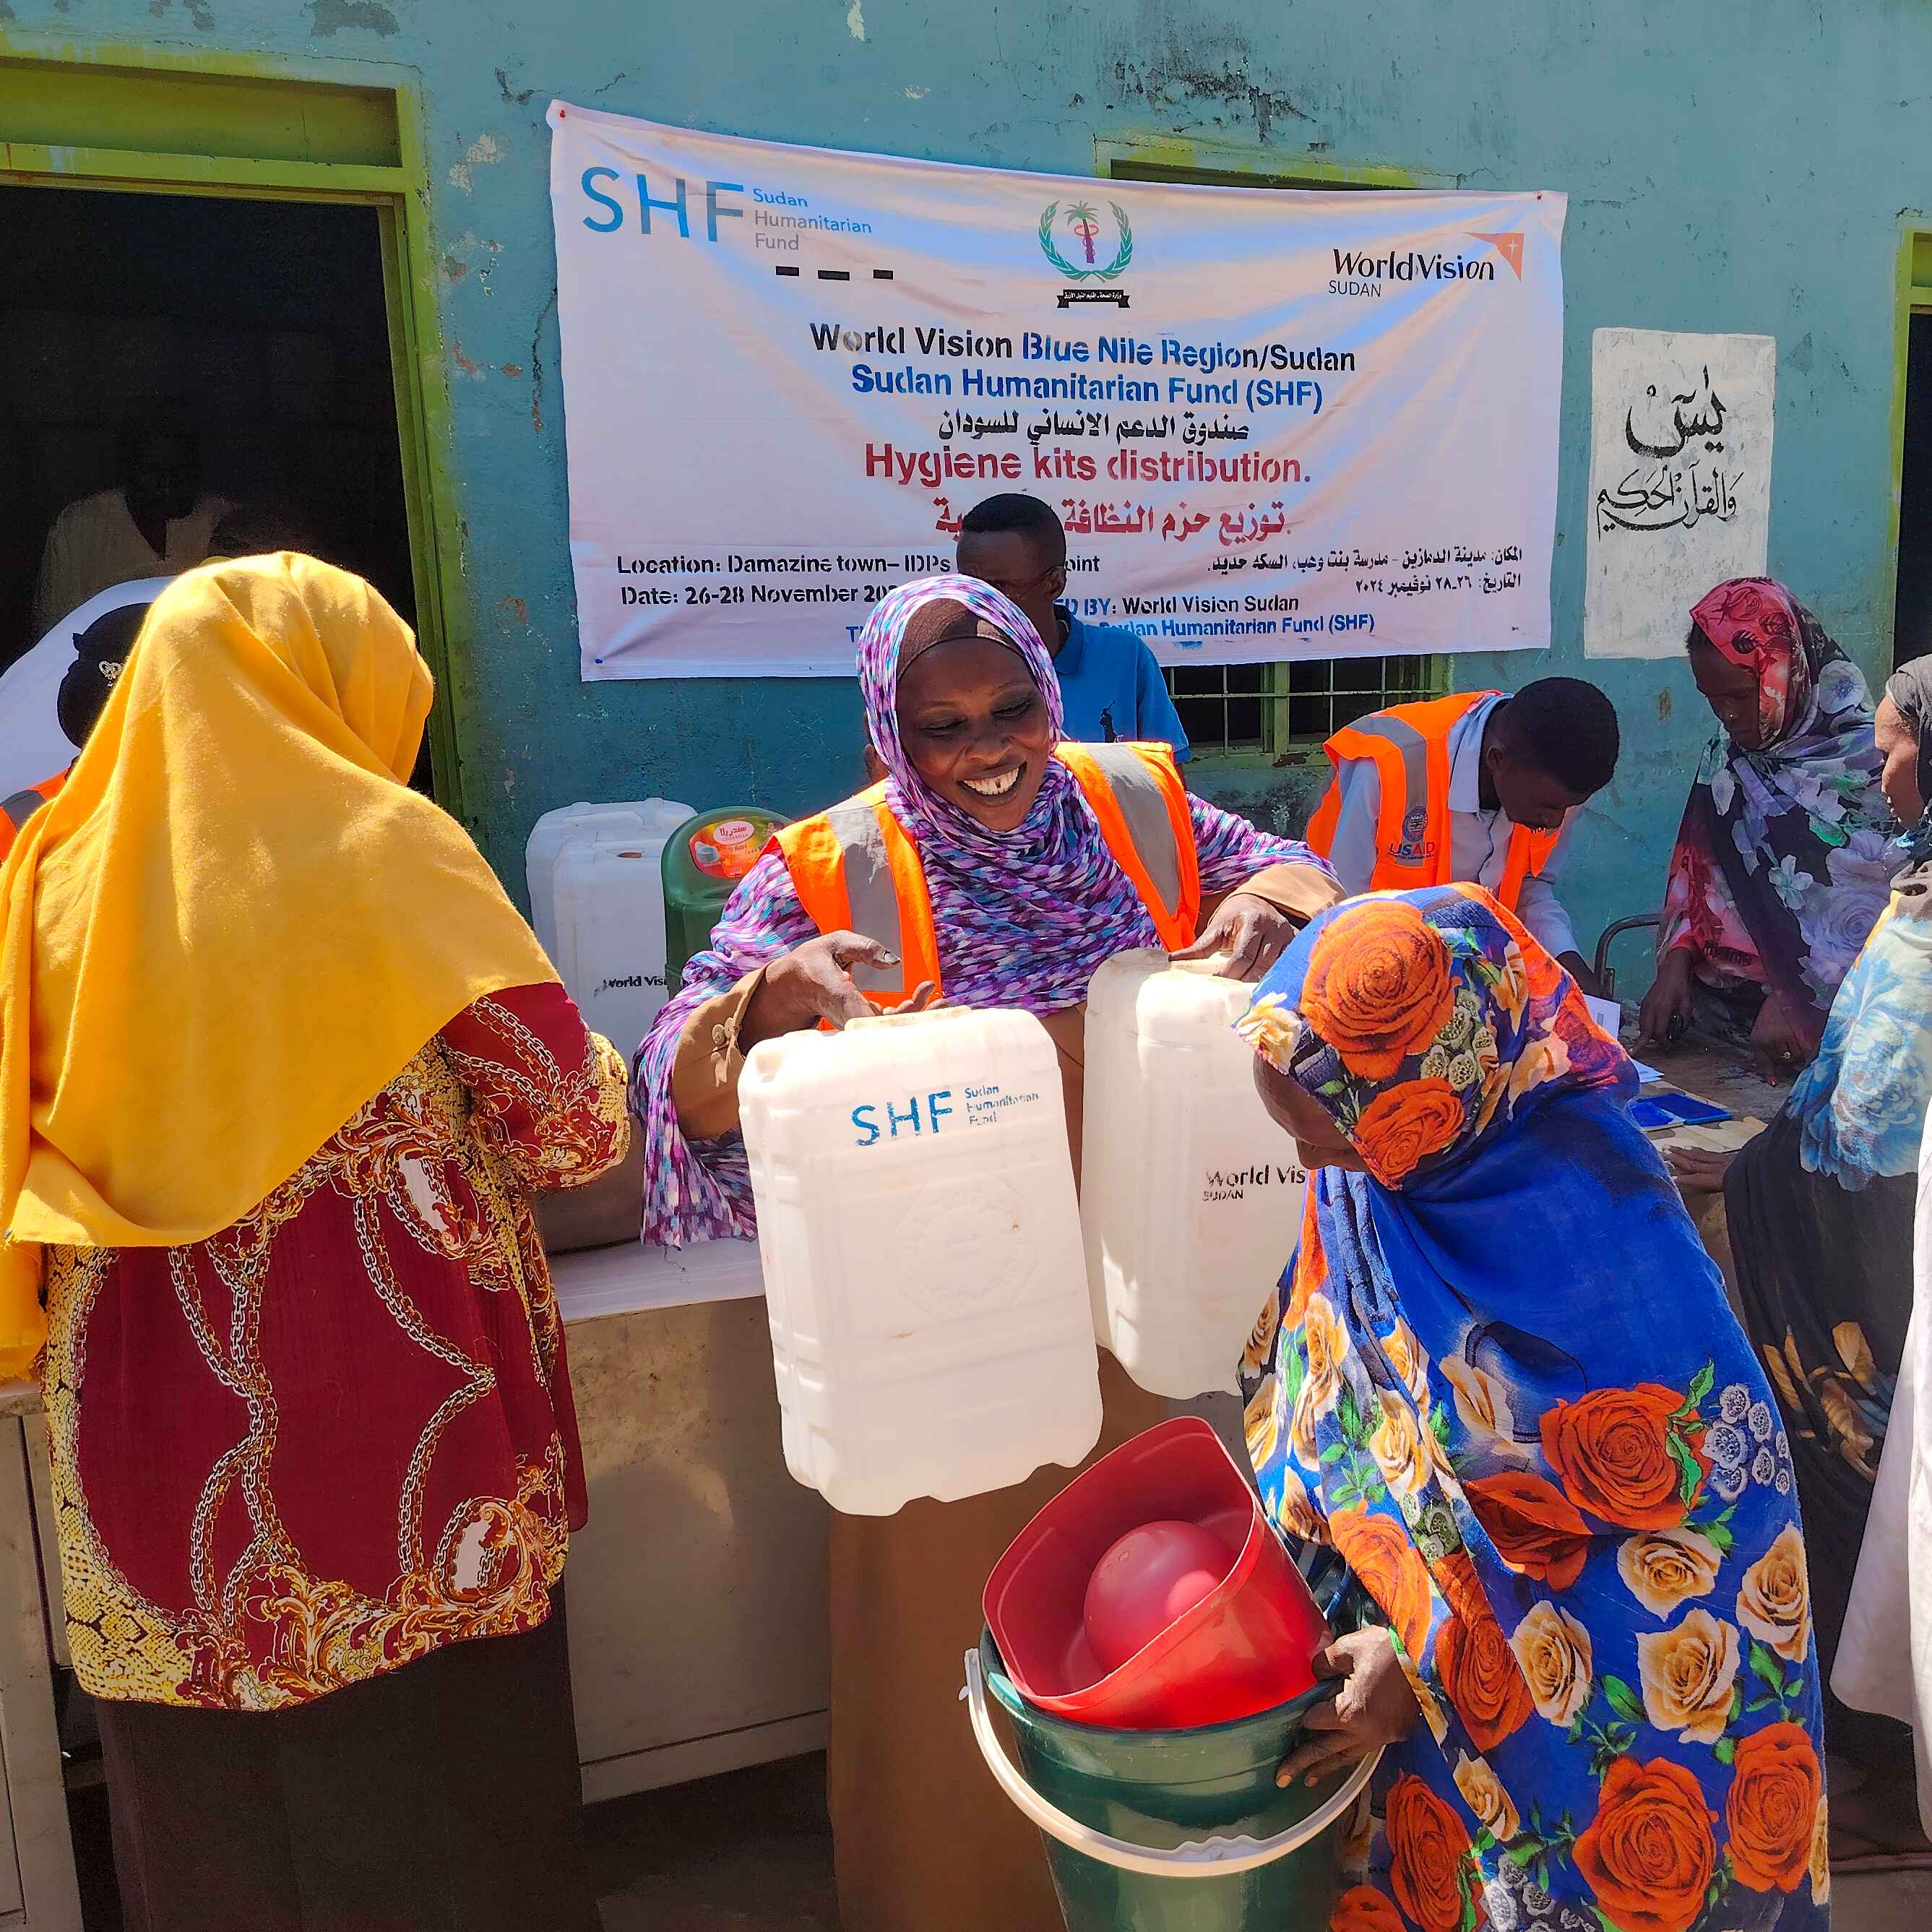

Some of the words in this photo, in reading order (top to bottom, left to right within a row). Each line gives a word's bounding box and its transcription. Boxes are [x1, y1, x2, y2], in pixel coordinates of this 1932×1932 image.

[581, 166, 744, 242] SHF
[753, 188, 808, 208] Sudan
[754, 210, 871, 234] Humanitarian
[755, 233, 799, 251] Fund
[1328, 279, 1381, 298] SUDAN
[809, 322, 905, 355] World
[915, 327, 1012, 358] Vision
[1022, 332, 1090, 363] Blue
[1098, 335, 1152, 366] Nile
[1161, 337, 1355, 374] Region/Sudan
[852, 363, 951, 395] Sudan
[962, 367, 1159, 402] Humanitarian
[1168, 377, 1237, 405] Fund
[1246, 379, 1323, 414] (SHF)
[939, 408, 1018, 439] للسودان
[1027, 408, 1110, 445] الانساني
[1116, 415, 1176, 444] الدعم
[1182, 411, 1249, 445] صندوق
[866, 443, 1022, 487] Hygiene
[1034, 446, 1096, 481] kits
[1107, 449, 1311, 483] distribution.
[1061, 499, 1154, 535] النظافة
[1162, 501, 1210, 542] حزم
[617, 555, 721, 574] Location:
[728, 554, 832, 573] Damazine
[904, 555, 950, 573] IDPs
[1065, 556, 1100, 572] oint
[1327, 549, 1350, 573] بنت
[1353, 548, 1389, 569] مدرسة
[1402, 548, 1451, 569] الدمازين
[1454, 546, 1486, 566] مدينة
[621, 587, 678, 605] Date:
[685, 586, 745, 605] 26-28
[751, 585, 858, 603] November
[1355, 578, 1384, 594] ٢٠٢٤
[1084, 598, 1116, 616] BY:
[1122, 596, 1176, 615] World
[1183, 595, 1239, 613] Vision
[1244, 595, 1299, 612] Sudan
[1162, 618, 1277, 637] Humanitarian
[1282, 616, 1324, 634] Fund
[1328, 613, 1375, 634] (SHF)
[1388, 842, 1435, 857] USAID
[965, 1085, 999, 1099] Sudan
[850, 1091, 953, 1147] SHF
[1206, 1164, 1269, 1187] World
[1276, 1165, 1306, 1184] Vis
[1202, 1189, 1243, 1201] SUDAN
